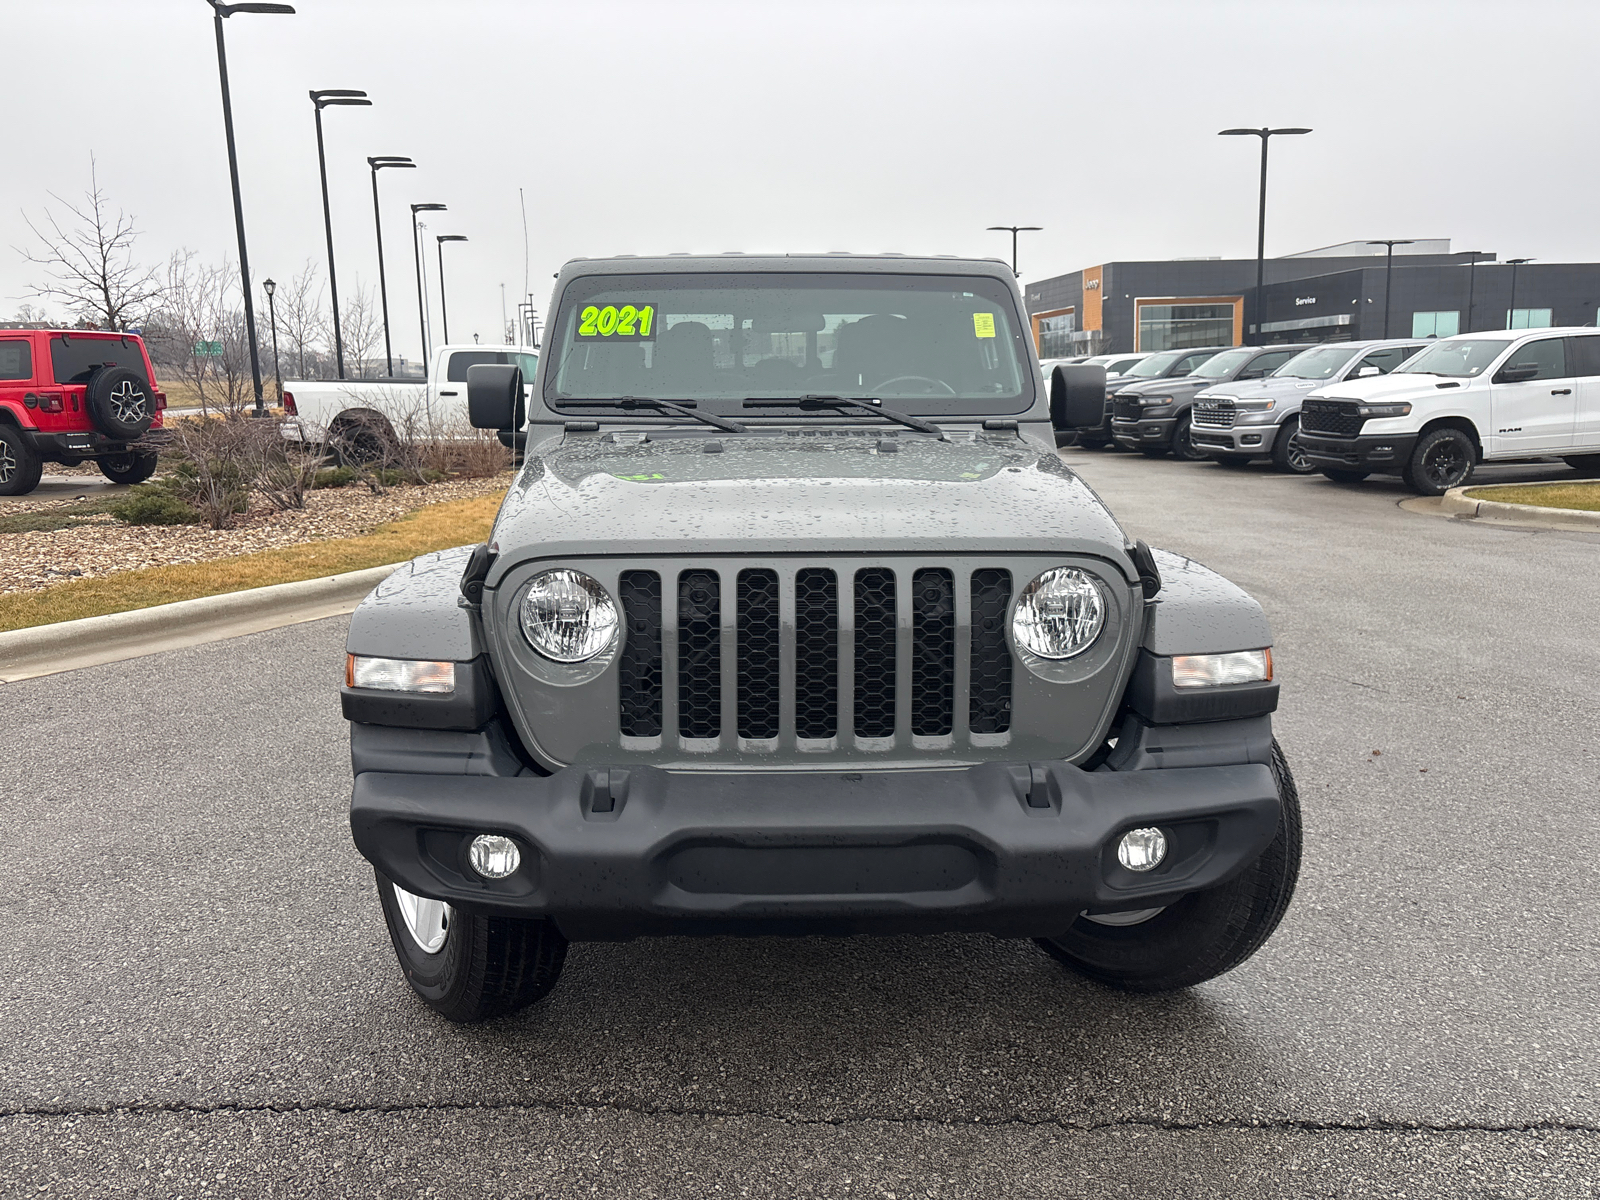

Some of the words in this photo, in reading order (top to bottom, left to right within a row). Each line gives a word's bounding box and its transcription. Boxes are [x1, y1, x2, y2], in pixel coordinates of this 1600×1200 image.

[1295, 296, 1316, 306] Service
[578, 305, 654, 337] 2021
[1198, 402, 1218, 410] RAM
